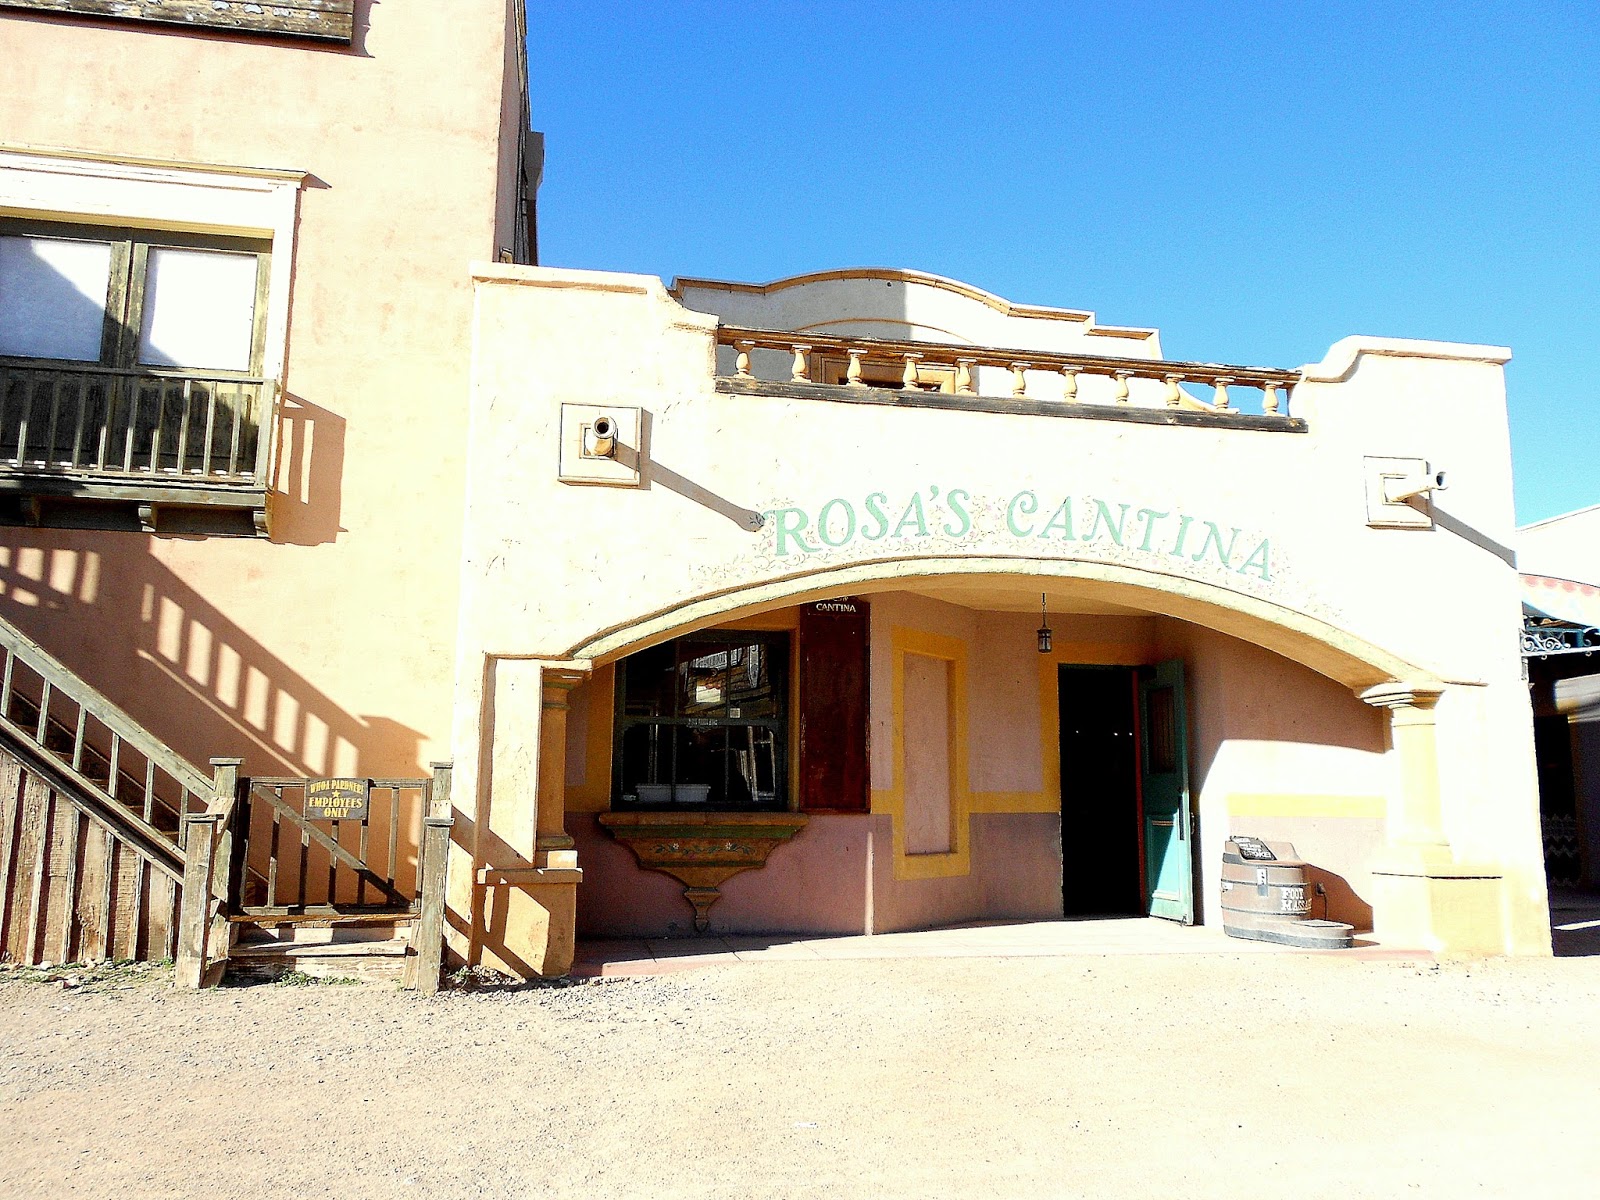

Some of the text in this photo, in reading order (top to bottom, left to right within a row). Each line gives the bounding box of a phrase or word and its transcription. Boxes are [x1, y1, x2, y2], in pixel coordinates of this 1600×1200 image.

[763, 485, 1271, 582] ROSA'S CANTINA
[815, 603, 857, 613] CANTINA
[310, 780, 330, 794] WHOA
[309, 797, 363, 809] EMPLOYEES
[323, 808, 349, 818] ONLY
